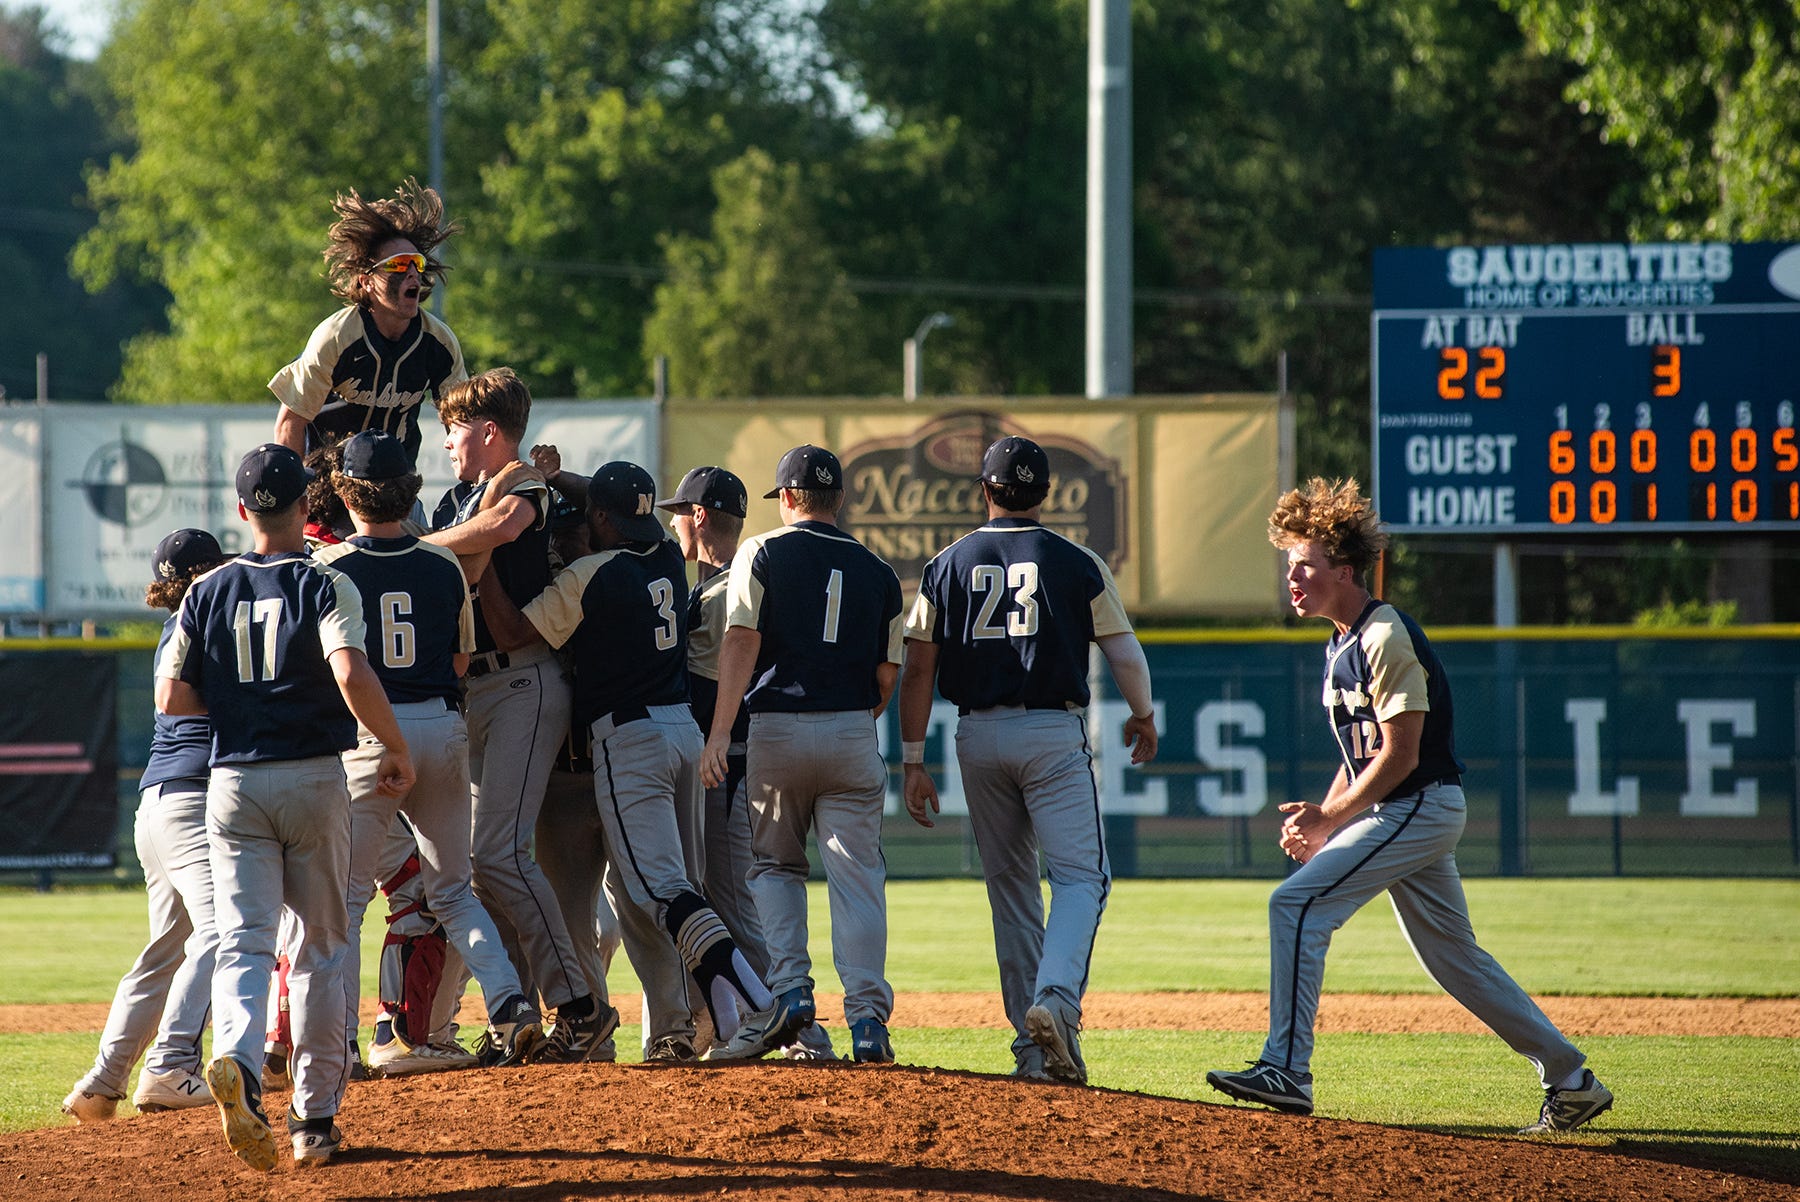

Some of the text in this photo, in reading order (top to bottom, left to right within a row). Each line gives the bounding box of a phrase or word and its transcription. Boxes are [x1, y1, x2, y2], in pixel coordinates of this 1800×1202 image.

[1446, 243, 1733, 287] SAUGERTIES
[1466, 283, 1714, 307] HOME OF SAUGERTIES
[1422, 314, 1522, 348] AT BAT
[1626, 312, 1704, 345] BALL
[1437, 346, 1506, 400] 22
[1652, 344, 1682, 398] 3
[1554, 400, 1795, 430] 1 2 3 4 5 6
[1405, 434, 1518, 475] GUEST
[1548, 427, 1799, 474] 6 0 0 0 0 5
[635, 494, 653, 516] N
[1408, 487, 1516, 526] HOME
[1549, 479, 1799, 524] 0 0 1 1 0 1
[647, 577, 678, 651] 3
[822, 568, 843, 643] 1
[971, 561, 1039, 640] 23
[233, 598, 284, 684] 17
[380, 591, 415, 669] 6
[1351, 720, 1380, 759] 12
[1565, 698, 1759, 817] LE
[858, 1040, 874, 1049] NIKE
[177, 1079, 201, 1096] N
